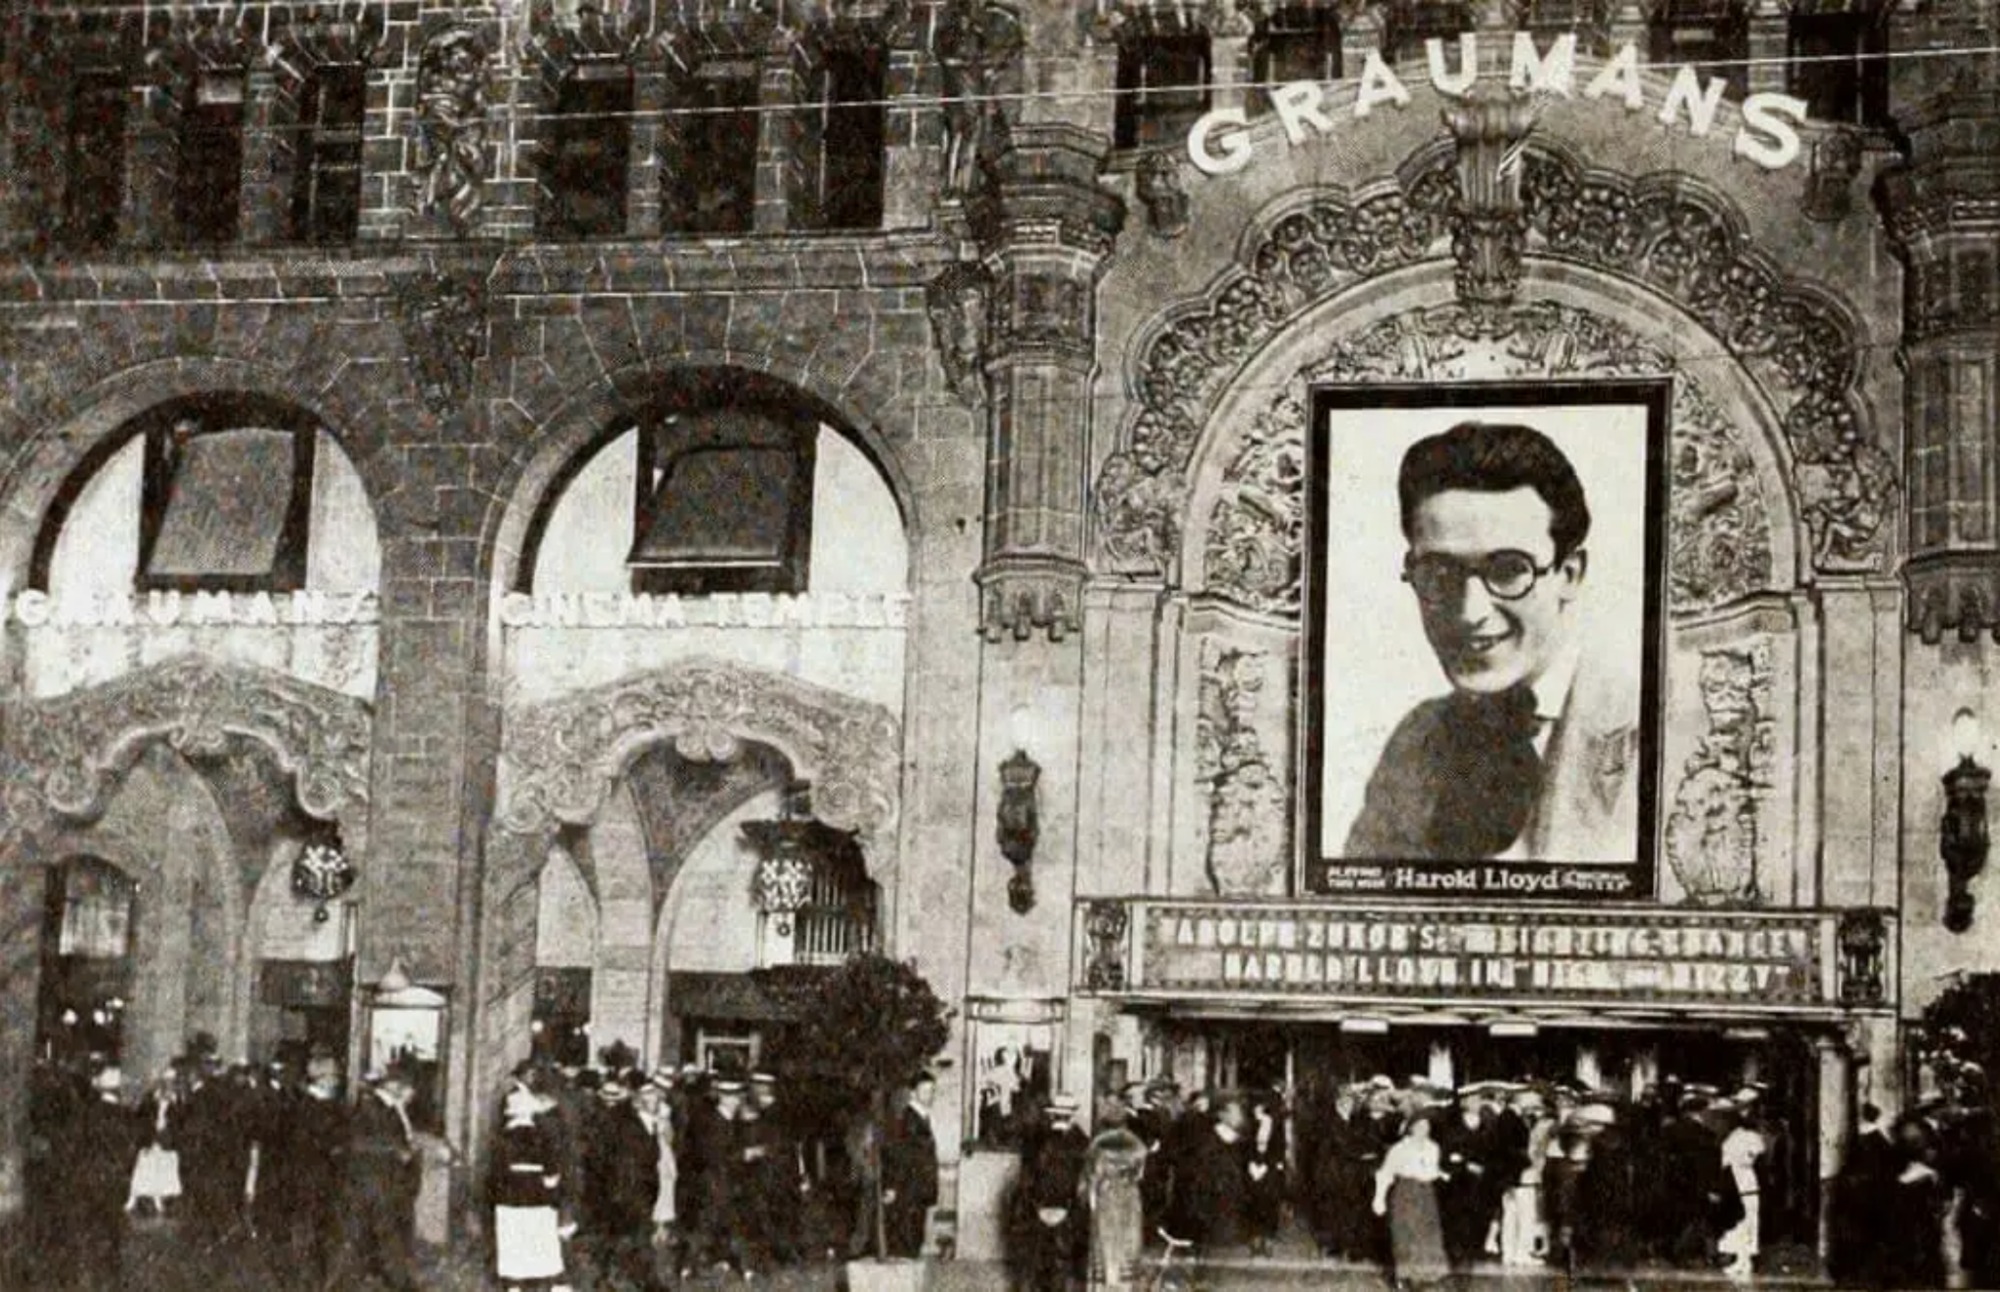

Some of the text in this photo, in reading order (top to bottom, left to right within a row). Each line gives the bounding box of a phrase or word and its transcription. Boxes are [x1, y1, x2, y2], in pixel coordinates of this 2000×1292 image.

[1187, 31, 1809, 171] GRAUMANS
[1395, 867, 1477, 889] Harold
[1484, 867, 1560, 892] Lloyd
